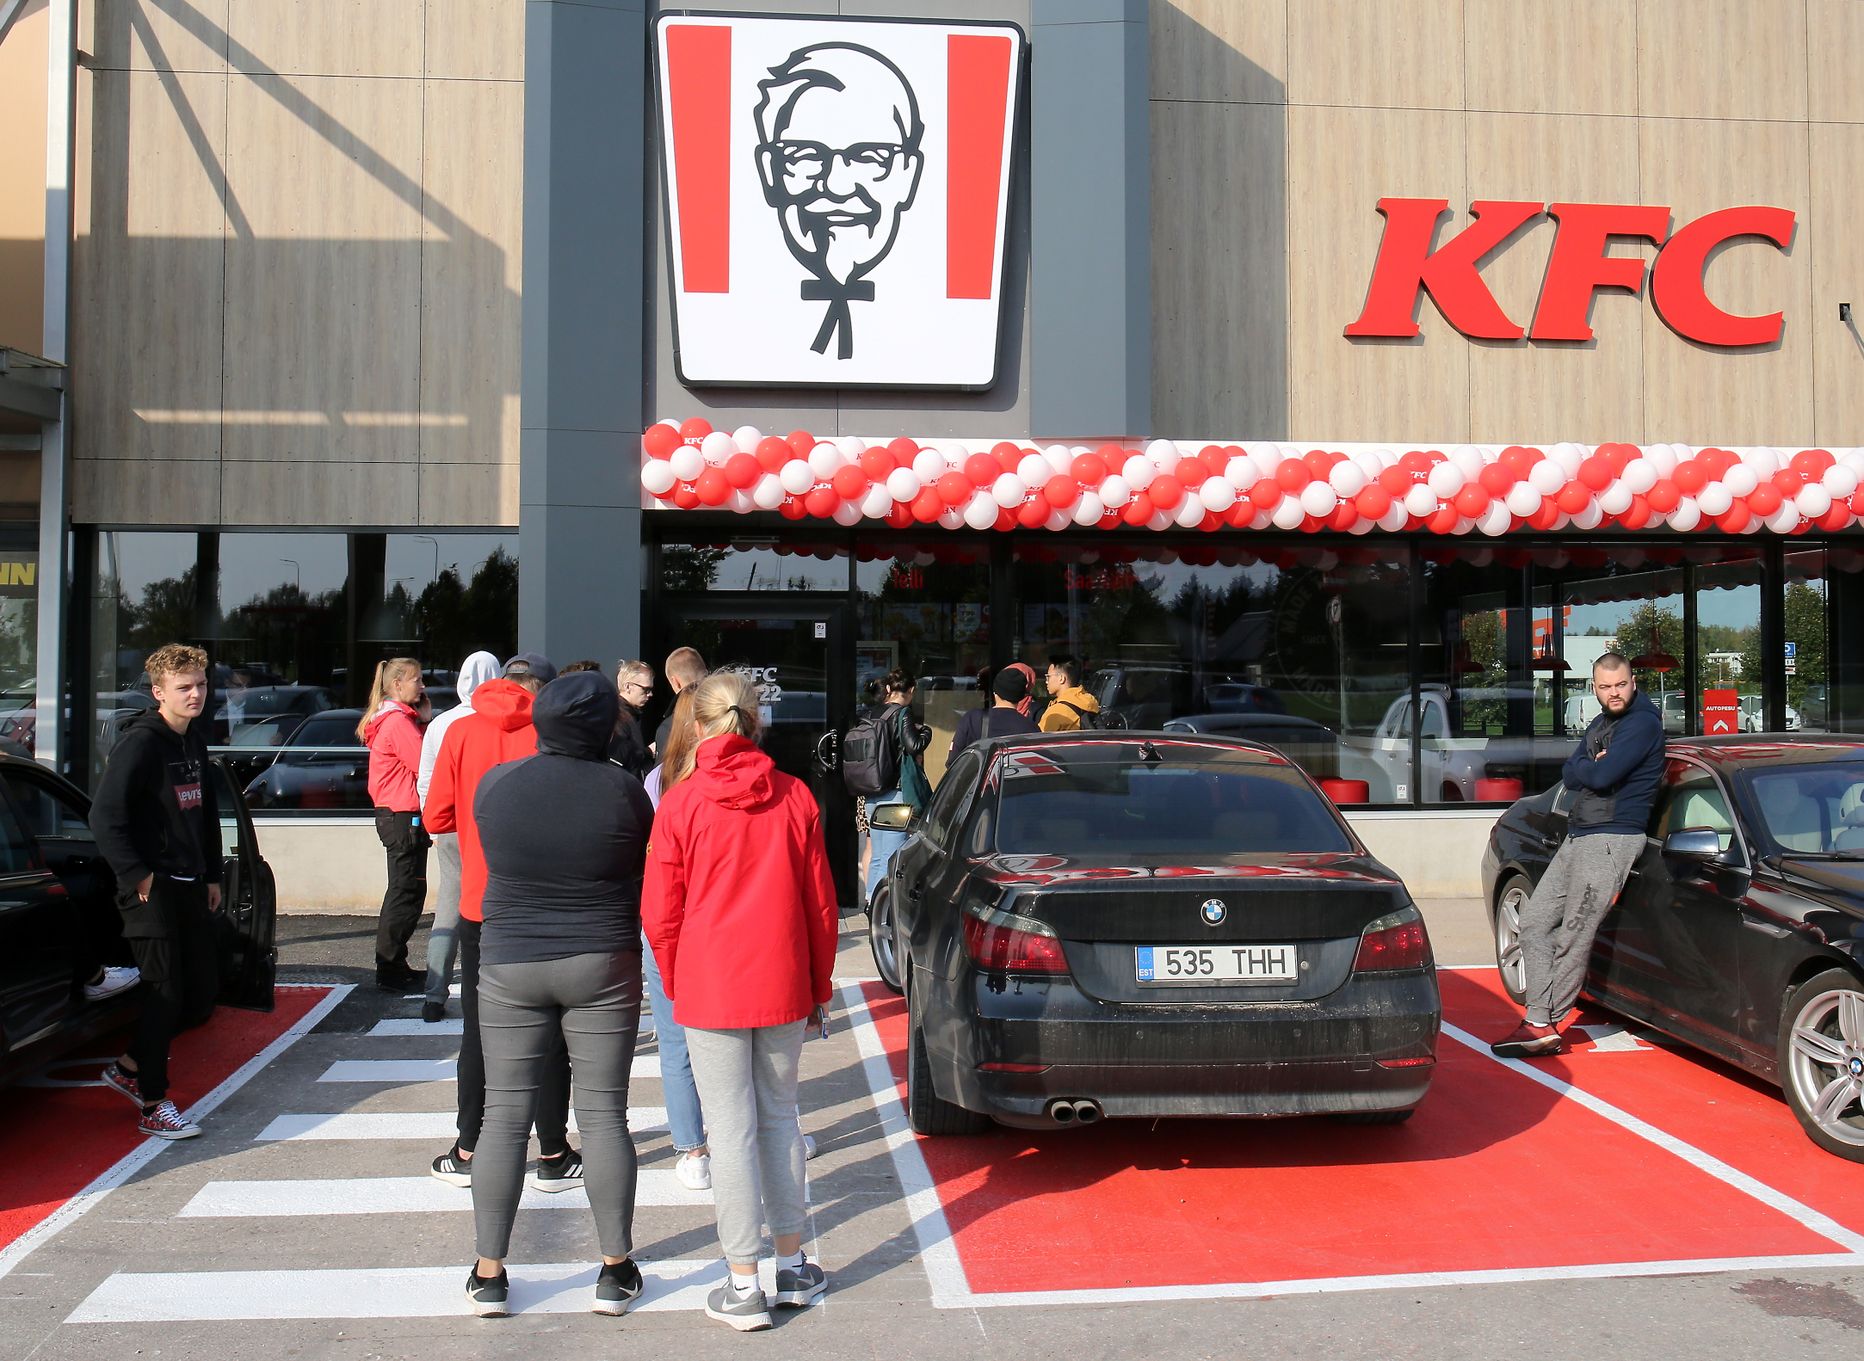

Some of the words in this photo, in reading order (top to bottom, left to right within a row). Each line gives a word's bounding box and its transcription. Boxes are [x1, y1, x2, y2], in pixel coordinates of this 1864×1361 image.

[1344, 197, 1796, 347] KFC
[684, 437, 704, 445] KFC
[1103, 508, 1119, 516] KF
[1166, 950, 1214, 976] 535
[1232, 949, 1286, 975] THH
[1138, 968, 1154, 977] EST
